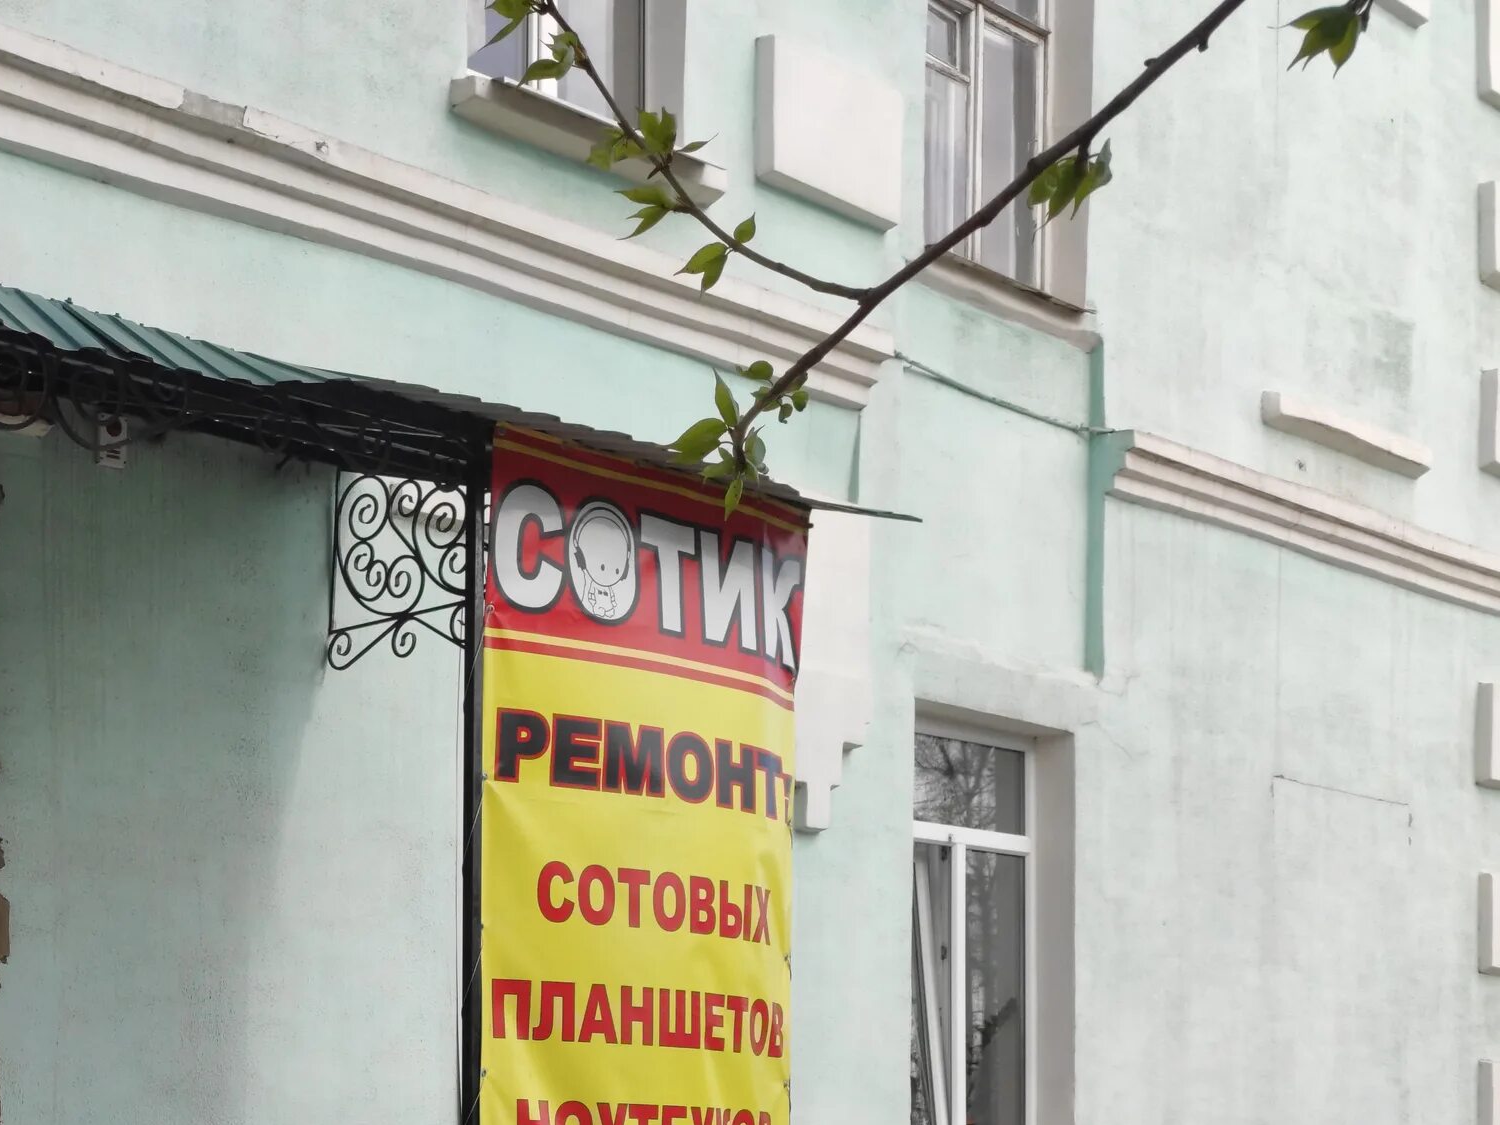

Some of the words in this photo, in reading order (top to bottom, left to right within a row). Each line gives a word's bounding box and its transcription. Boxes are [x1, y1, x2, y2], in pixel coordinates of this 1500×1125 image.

[493, 480, 802, 669] СОТИК
[537, 860, 771, 946] СОТОВЫХ
[491, 978, 784, 1058] ПЛАНШЕТОВ
